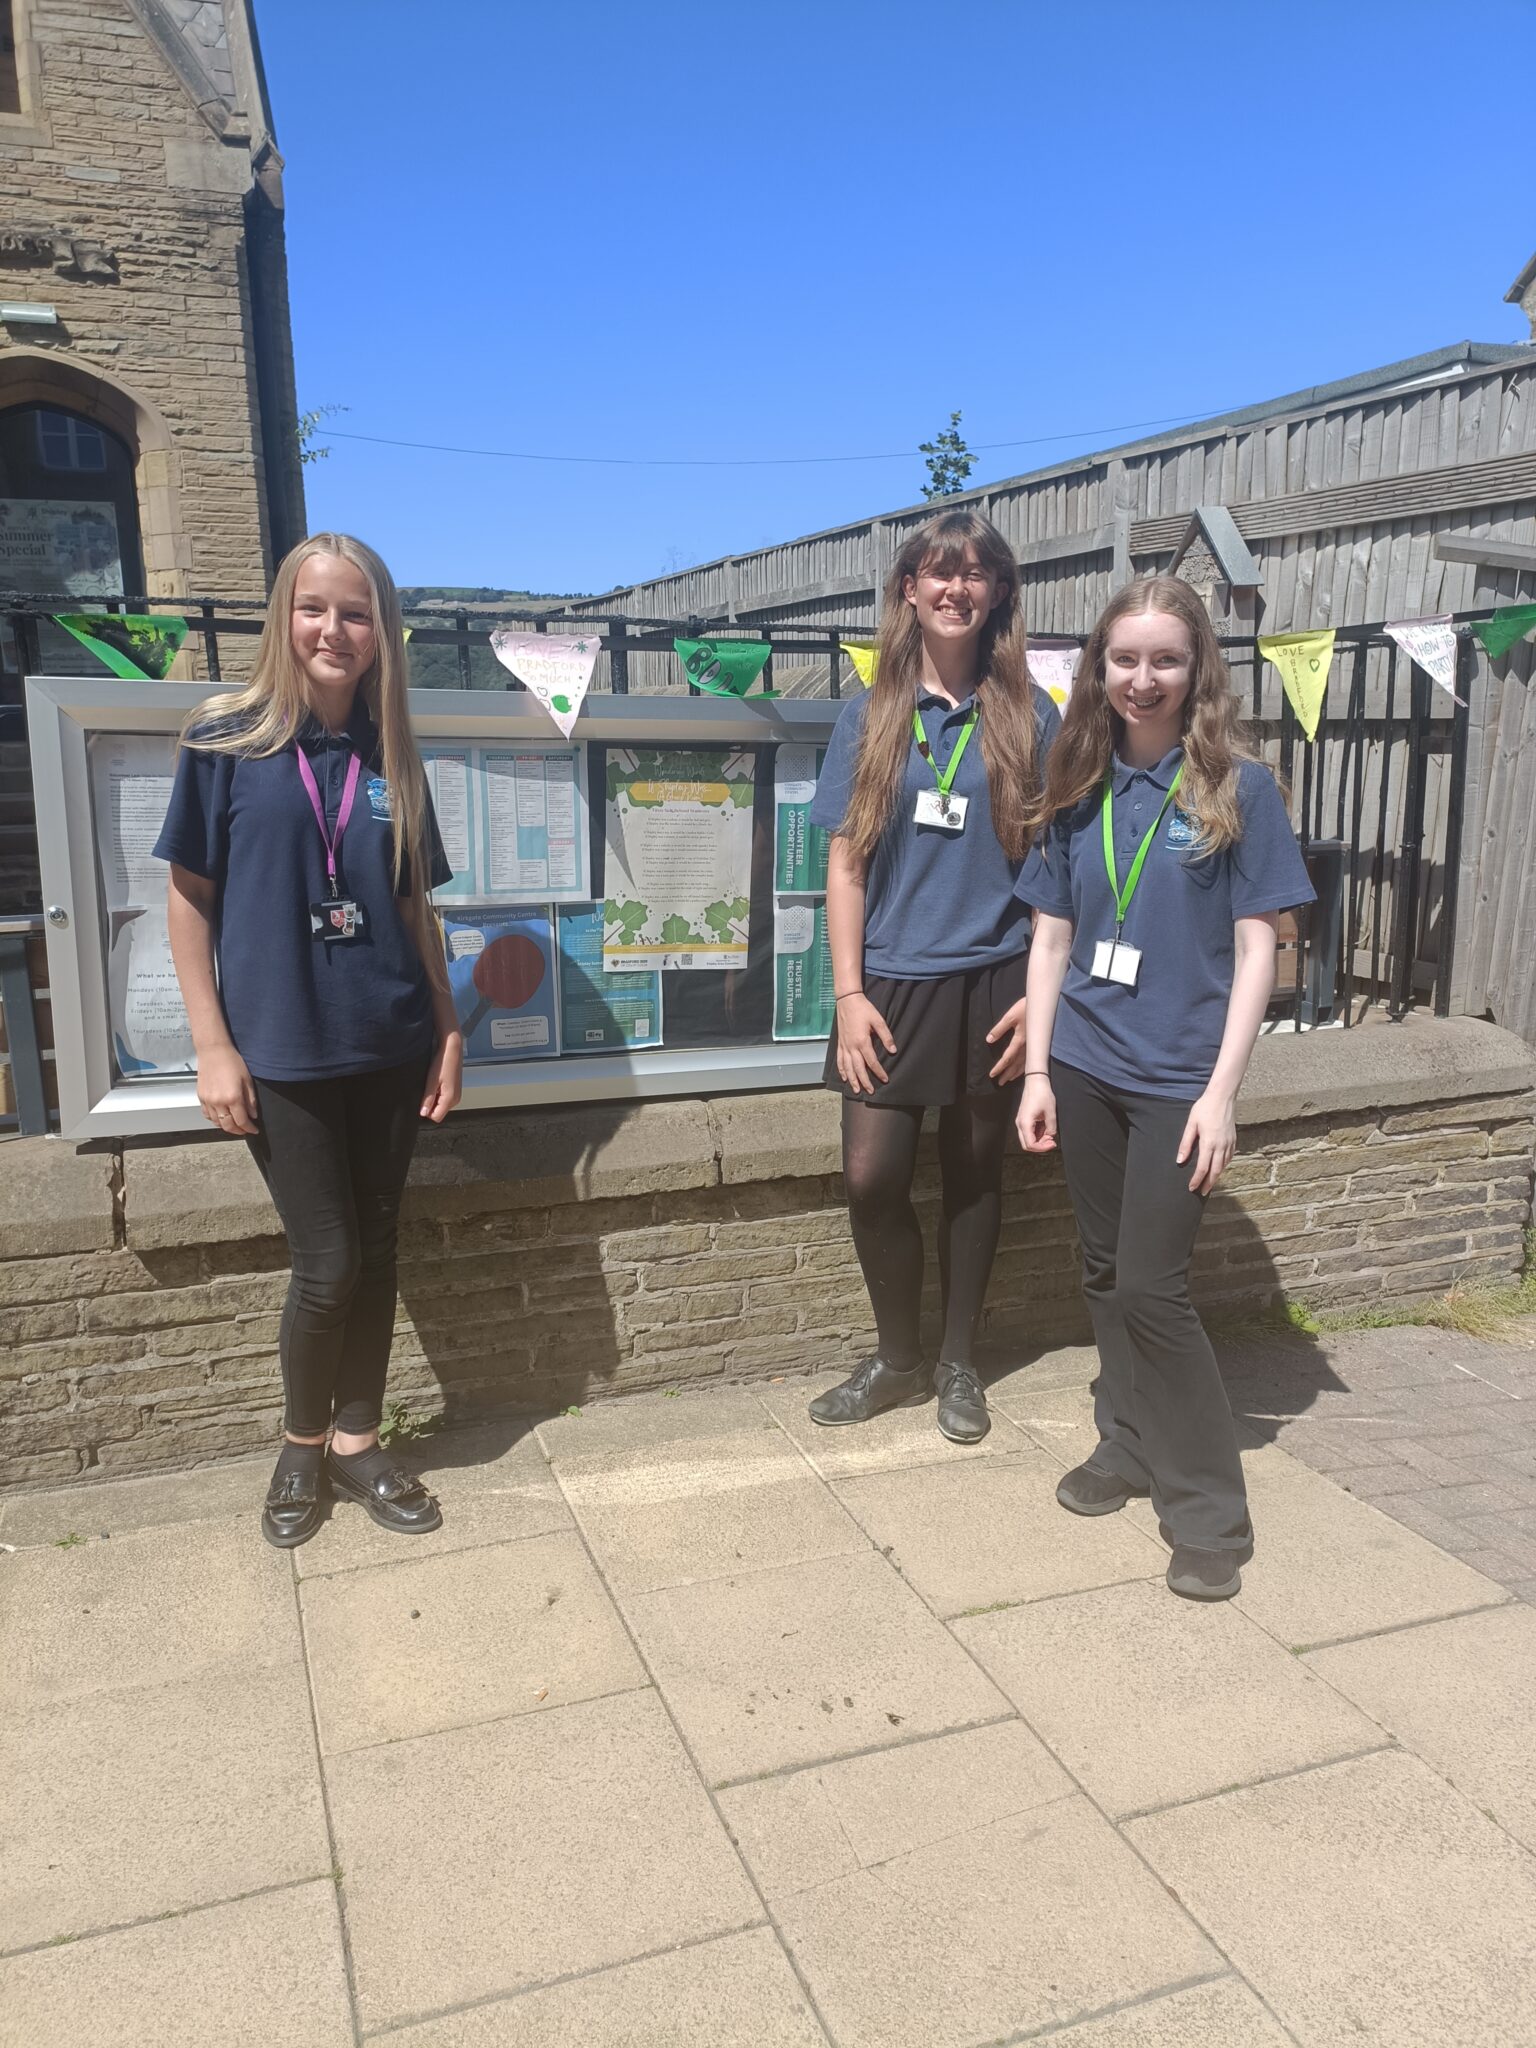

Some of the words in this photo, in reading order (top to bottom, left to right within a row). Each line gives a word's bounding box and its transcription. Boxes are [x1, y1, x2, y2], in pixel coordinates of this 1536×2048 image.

[1275, 645, 1305, 657] LOVE
[1417, 638, 1440, 657] HOW
[1440, 634, 1456, 648] TO
[539, 671, 571, 683] MUCH
[786, 810, 796, 885] OPPORTUNITIES
[796, 810, 805, 866] VOLUNTEER
[482, 912, 517, 920] Community
[786, 960, 794, 1024] RECRUITMENT
[795, 959, 803, 999] TRUSTEE
